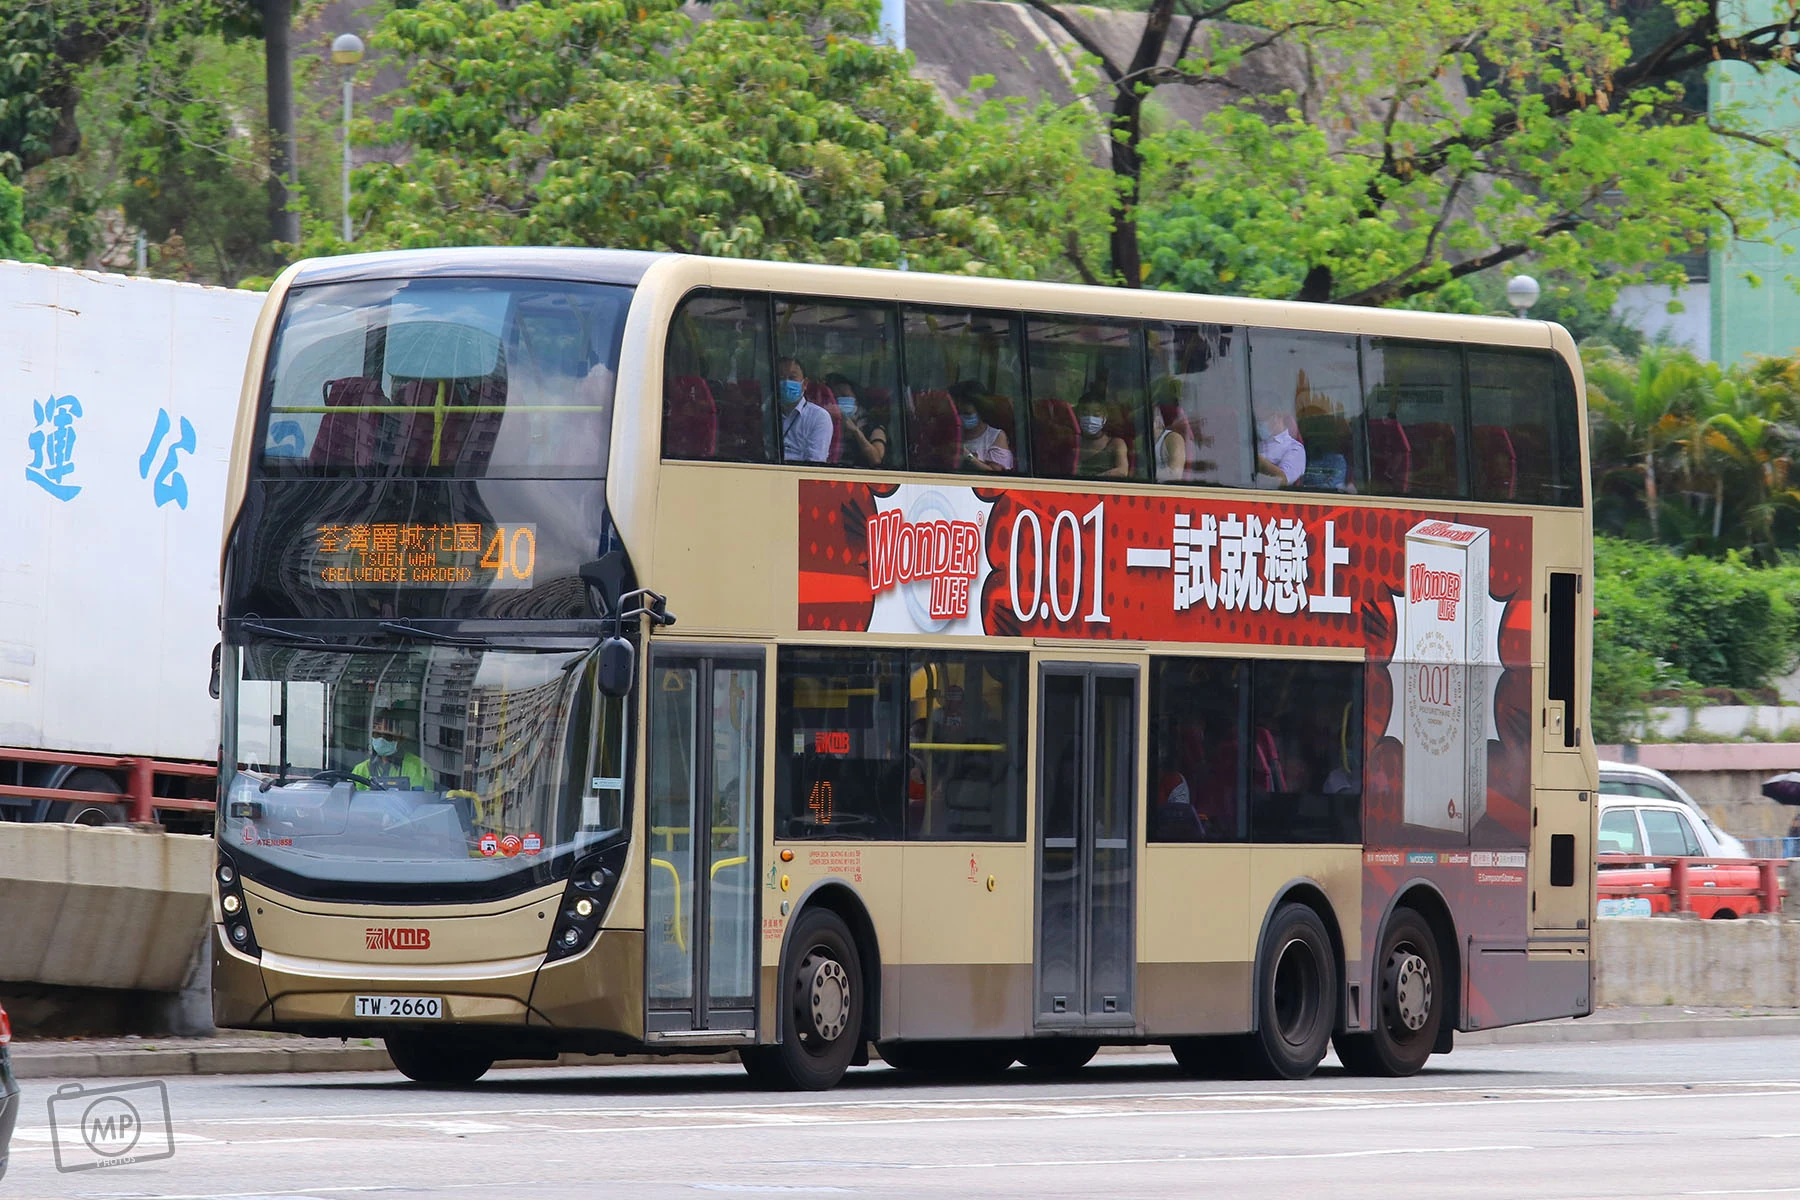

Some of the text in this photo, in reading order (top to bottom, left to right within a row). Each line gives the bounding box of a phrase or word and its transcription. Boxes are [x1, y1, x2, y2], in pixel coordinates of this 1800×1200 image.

[316, 523, 481, 552] 荃灣麗城花園
[360, 552, 436, 566] TSUEN WAN
[480, 527, 537, 580] 40
[1009, 501, 1110, 623] 0.01
[1127, 513, 1351, 613] 一試就戀上
[321, 567, 472, 582] (BELVEDERE GARDEN)
[930, 576, 968, 619] LIFE
[1438, 599, 1456, 621] LIFE
[1418, 664, 1452, 707] 0.01
[825, 732, 850, 753] KMB
[809, 781, 832, 824] 40
[1409, 855, 1434, 864] watsons
[384, 928, 431, 950] KMB
[358, 997, 438, 1016] TW 2660
